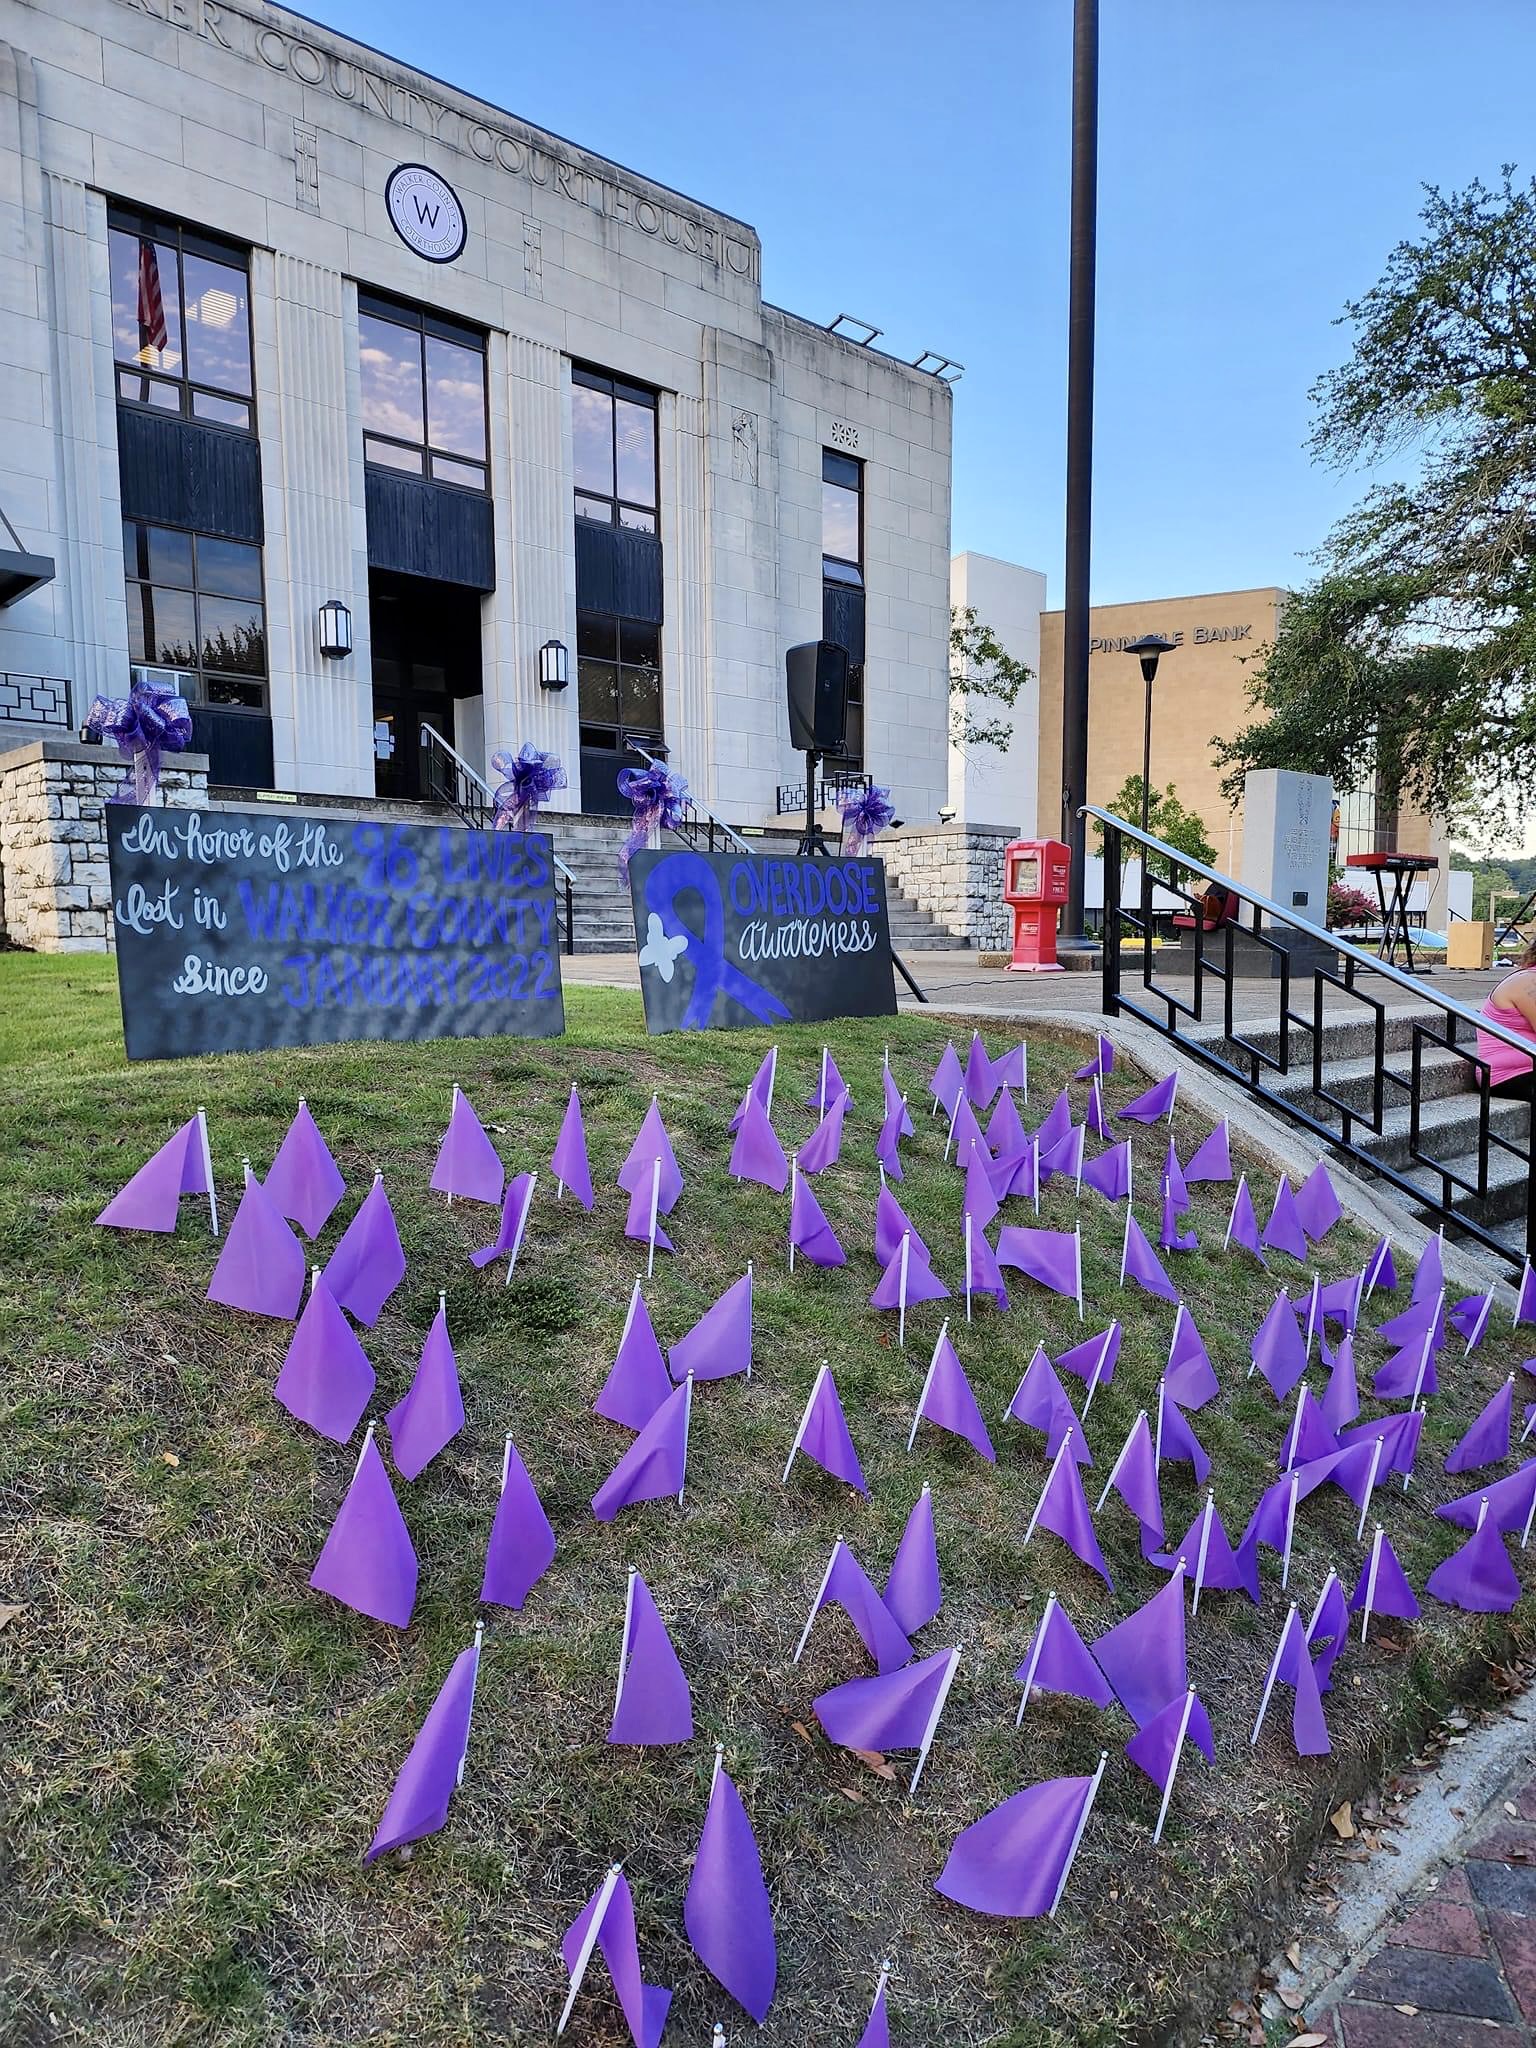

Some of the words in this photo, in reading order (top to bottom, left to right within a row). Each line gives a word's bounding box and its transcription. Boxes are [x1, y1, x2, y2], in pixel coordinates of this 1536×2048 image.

[256, 30, 448, 141] COUNTY
[395, 174, 424, 195] WALKER
[426, 178, 457, 218] COUNTY
[413, 194, 440, 230] W
[400, 218, 454, 253] COURTHOUSE
[1193, 624, 1252, 645] BANK
[121, 813, 178, 859] In
[174, 812, 256, 864] honor
[259, 822, 295, 873] of
[295, 821, 344, 868] the
[352, 822, 420, 891] 96
[439, 827, 550, 888] LIVES
[193, 887, 227, 930] in
[237, 879, 394, 948] WALKER
[406, 891, 557, 949] COUNTY
[730, 858, 879, 917] OVERDOSE
[173, 954, 268, 995] Since
[281, 952, 462, 1009] JANUARY
[468, 950, 559, 1000] 2022
